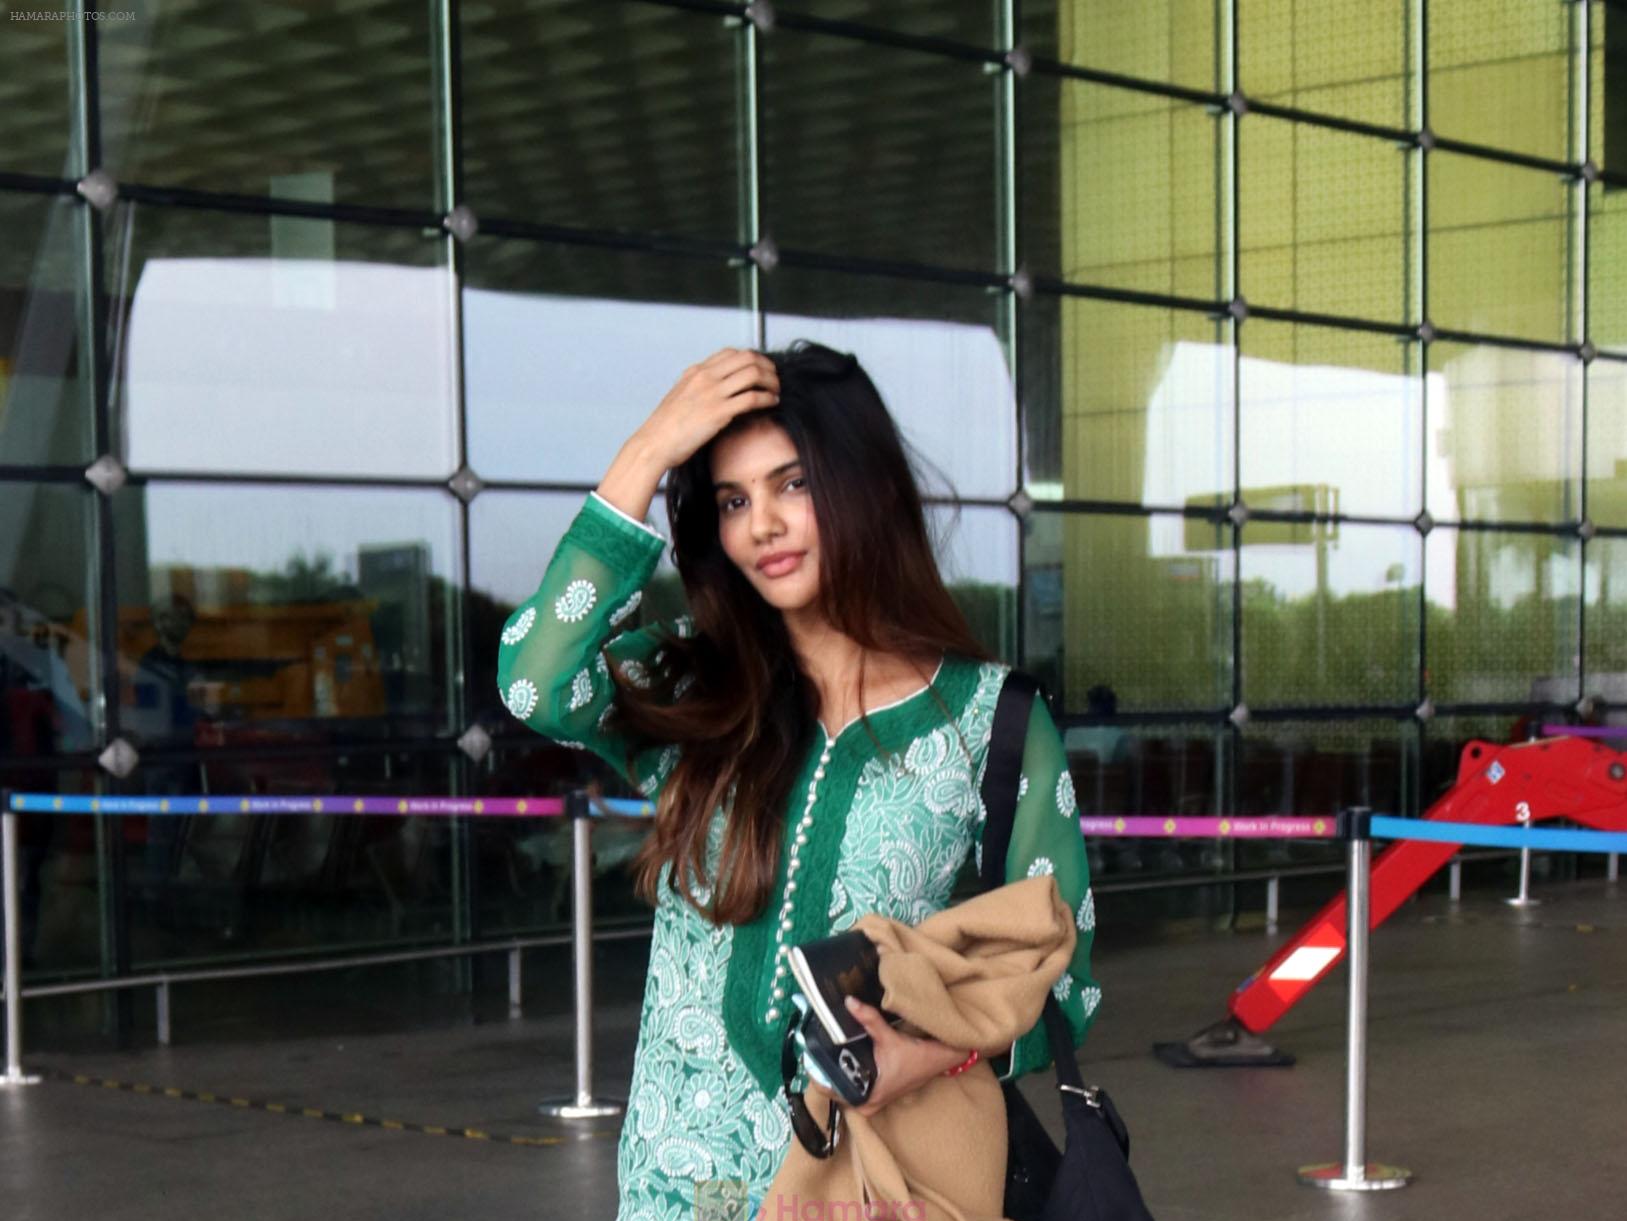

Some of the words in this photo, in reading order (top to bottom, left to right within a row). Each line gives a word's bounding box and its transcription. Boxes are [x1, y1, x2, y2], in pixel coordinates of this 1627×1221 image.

[1516, 801, 1531, 822] 3
[1233, 821, 1257, 832] Work
[1270, 821, 1311, 834] Progress
